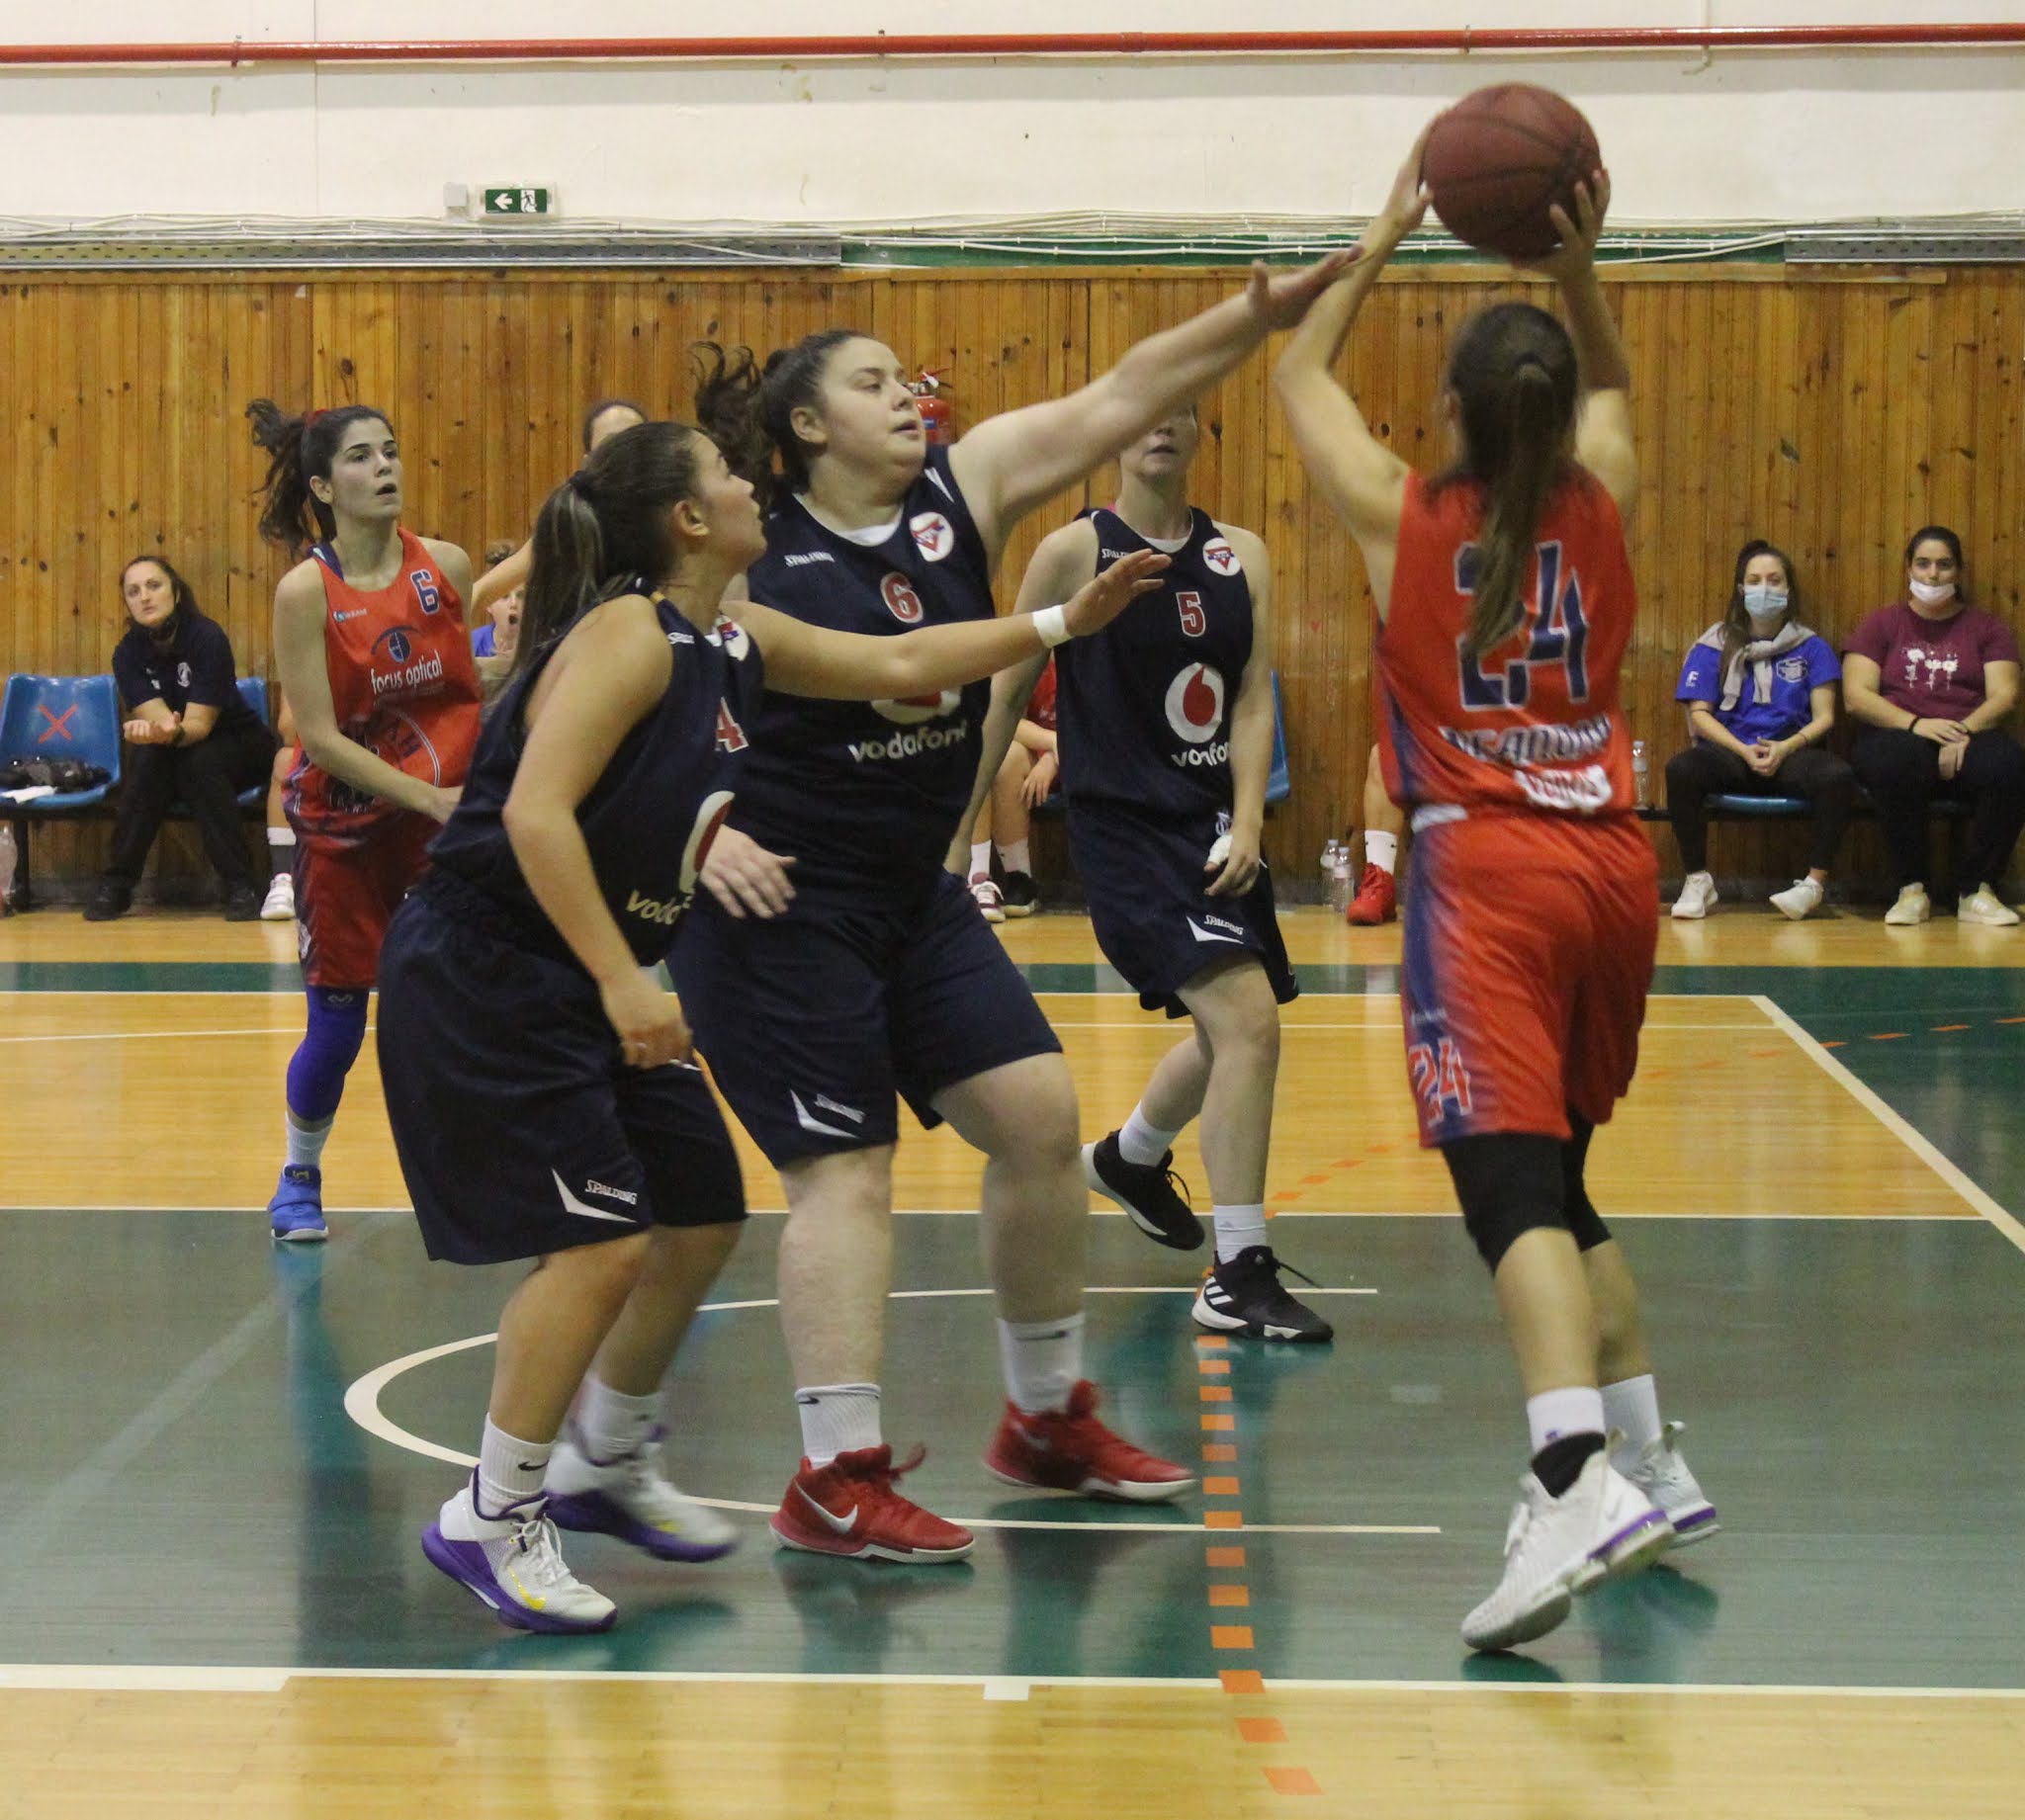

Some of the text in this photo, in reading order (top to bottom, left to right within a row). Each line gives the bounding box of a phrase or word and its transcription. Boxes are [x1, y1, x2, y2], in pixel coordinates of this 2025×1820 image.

[409, 567, 440, 615] 6
[880, 571, 924, 624] 6
[1176, 591, 1206, 637] 5
[1454, 540, 1589, 712] 24
[371, 667, 402, 695] focus
[405, 649, 443, 689] optical
[716, 696, 749, 753] 4
[847, 719, 968, 763] vodafon
[1408, 1036, 1473, 1128] 24
[585, 1178, 638, 1205] SPALDING
